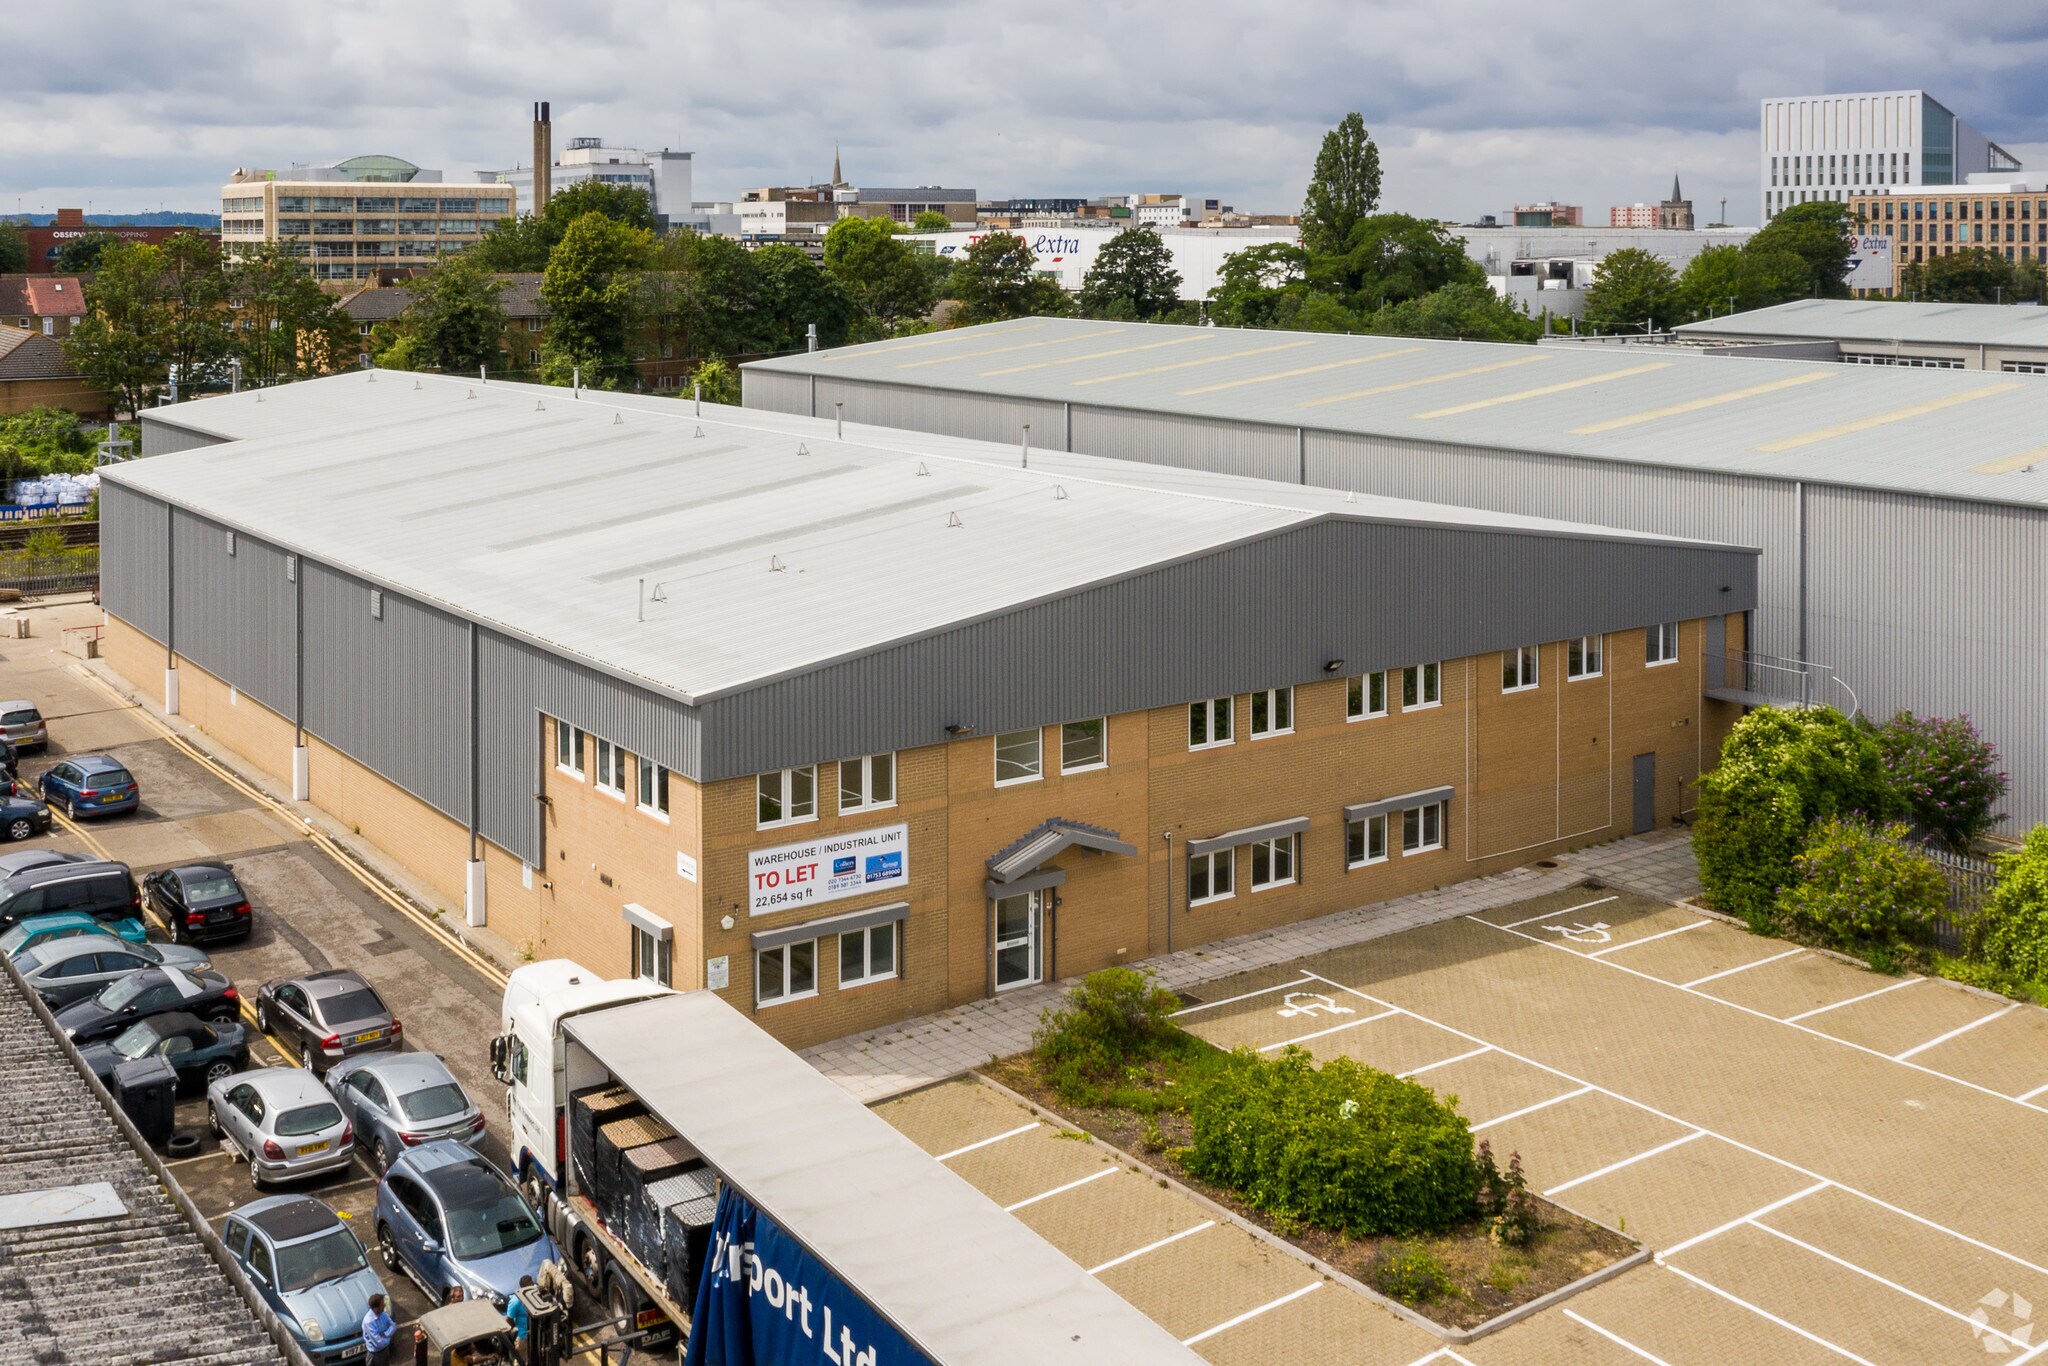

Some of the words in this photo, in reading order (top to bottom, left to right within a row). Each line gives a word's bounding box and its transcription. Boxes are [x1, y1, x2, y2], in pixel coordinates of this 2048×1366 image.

[1035, 234, 1080, 254] extra
[1862, 237, 1888, 250] extra
[754, 846, 817, 867] WAREHOUSE
[824, 835, 879, 854] INDUSTRIAL
[881, 831, 902, 843] UNIT
[882, 861, 899, 869] Group
[754, 870, 780, 890] TO
[785, 863, 819, 885] LET
[755, 891, 788, 908] 22,654
[790, 891, 803, 901] sq
[805, 887, 813, 898] ft
[641, 1329, 671, 1344] DAF
